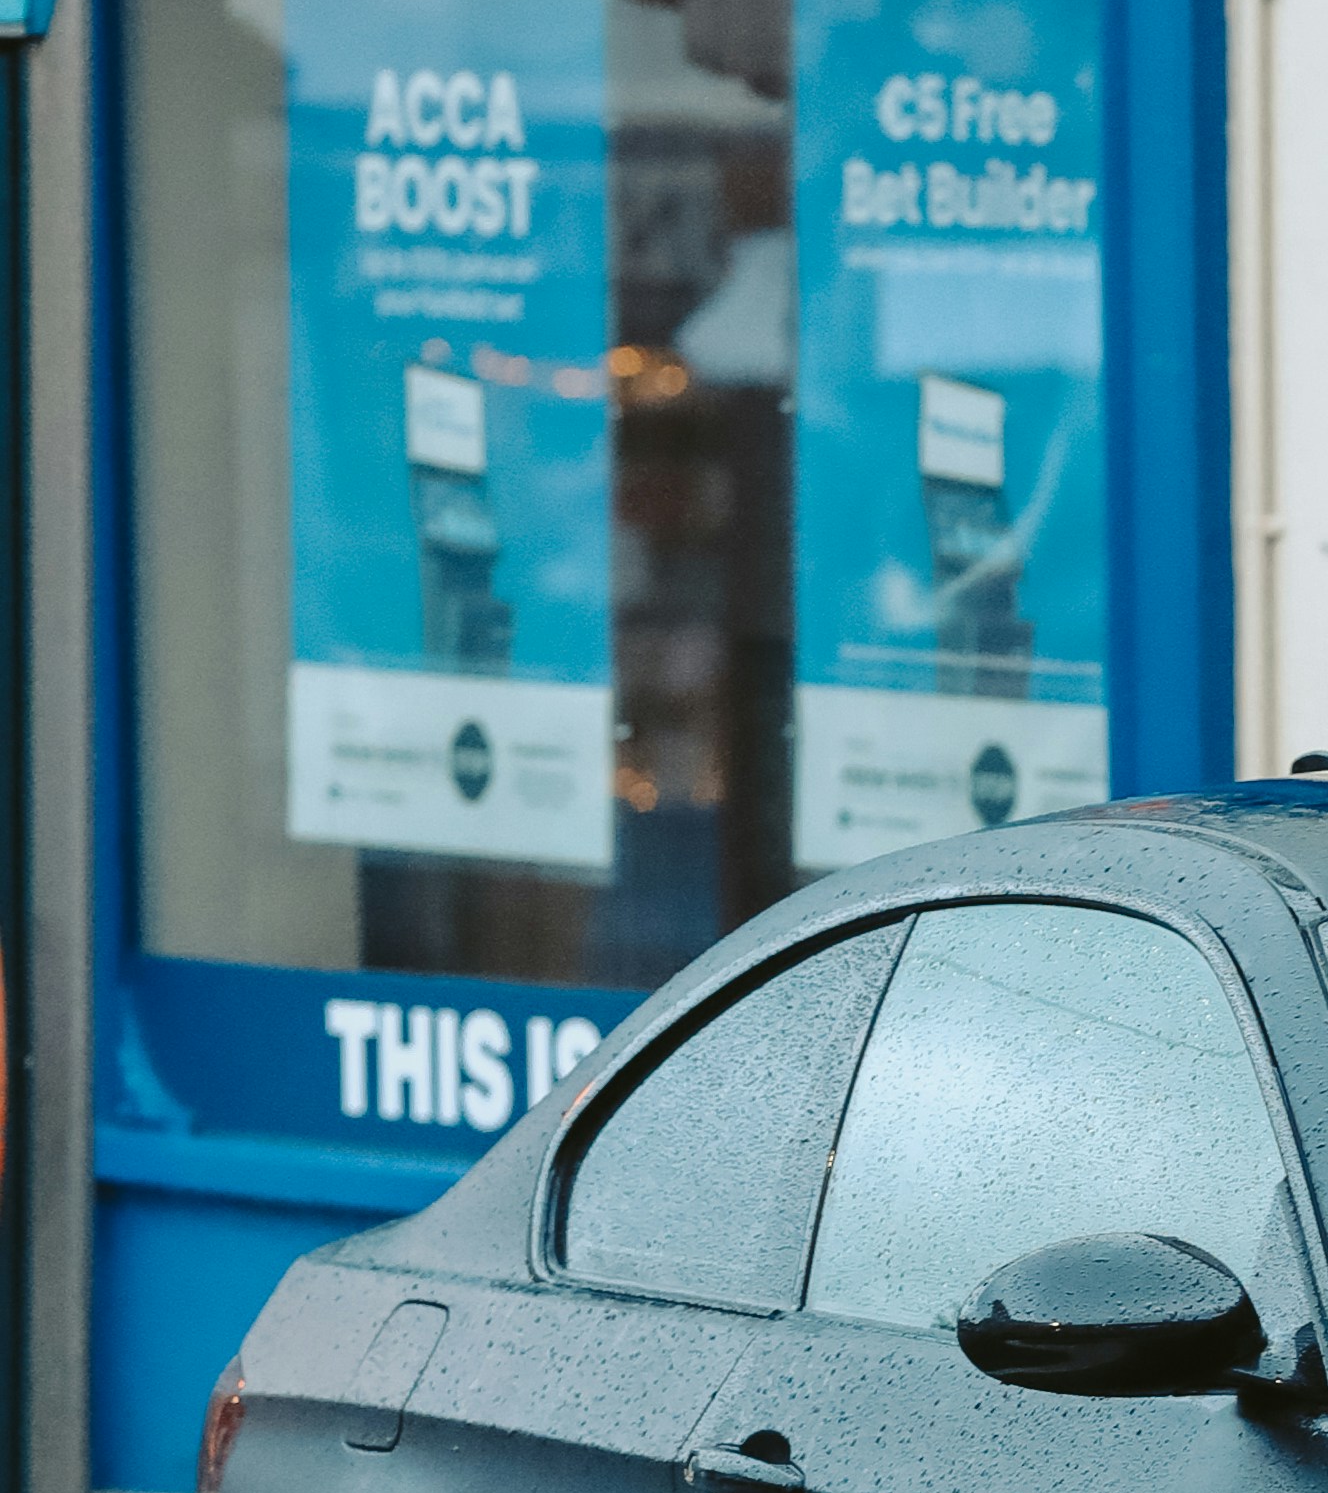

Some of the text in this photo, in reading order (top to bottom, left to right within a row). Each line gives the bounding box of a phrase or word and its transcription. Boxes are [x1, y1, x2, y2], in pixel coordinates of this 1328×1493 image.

[366, 71, 526, 149] ACCA
[952, 74, 1057, 146] Free
[355, 156, 540, 237] BOOST
[841, 157, 1097, 234] Bet Builder
[325, 998, 514, 1133] THIS
